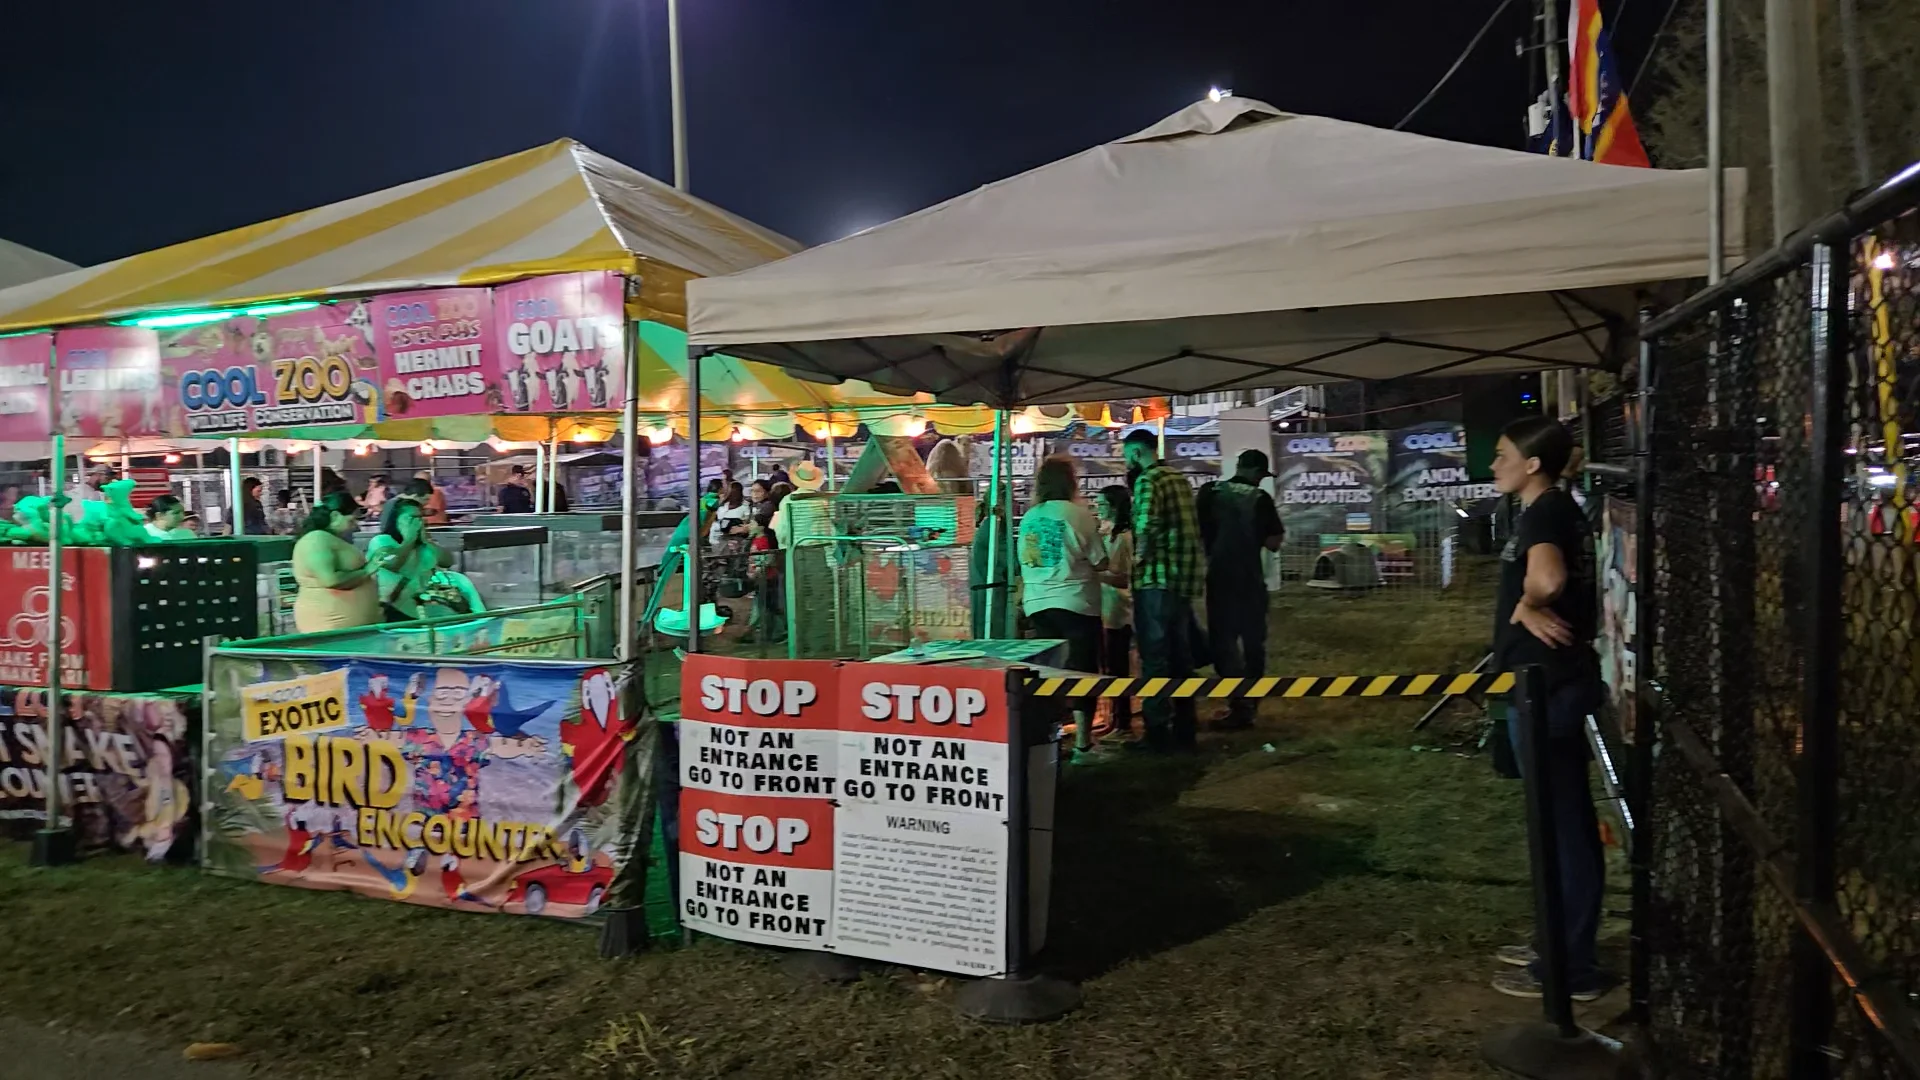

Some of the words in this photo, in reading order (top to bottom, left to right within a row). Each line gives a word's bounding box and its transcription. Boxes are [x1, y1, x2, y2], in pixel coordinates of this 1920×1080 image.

[386, 303, 436, 327] COOL
[394, 344, 482, 373] HERMIT
[181, 365, 266, 411] COOL
[272, 355, 351, 402] ZOO
[407, 372, 485, 400] CRABS
[188, 411, 248, 432] WILDLIFE
[254, 403, 355, 428] CONSERVATION
[1288, 438, 1333, 453] COOL
[1405, 433, 1457, 449] COOL
[1297, 472, 1360, 487] ANIMAL
[1284, 489, 1373, 503] ENCOUNTERS
[12, 551, 51, 569] MEE
[38, 652, 84, 669] FOM
[700, 674, 816, 716] STOP
[861, 682, 986, 725] STOP
[259, 697, 340, 735] EXOTIC
[710, 727, 750, 747] NOT
[759, 732, 794, 749] AN
[874, 737, 922, 758] NOT
[931, 742, 966, 761] AN
[283, 733, 408, 810] BIRD
[700, 747, 818, 772] ENTRANCE
[860, 759, 989, 786] ENTRANCE
[688, 765, 712, 784] GO
[719, 770, 744, 790] TO
[754, 774, 836, 795] FRONT
[843, 779, 875, 798] GO
[886, 783, 915, 802] TO
[927, 787, 1004, 812] FRONT
[358, 806, 567, 862] ENCOUNTER
[696, 809, 810, 853] STOP
[886, 815, 951, 835] WARNING
[706, 862, 746, 883] NOT
[754, 868, 786, 888] AN
[697, 880, 809, 912] ENTRANCE
[686, 900, 708, 919] GO
[716, 905, 739, 926] TO
[749, 910, 826, 937] FRONT
